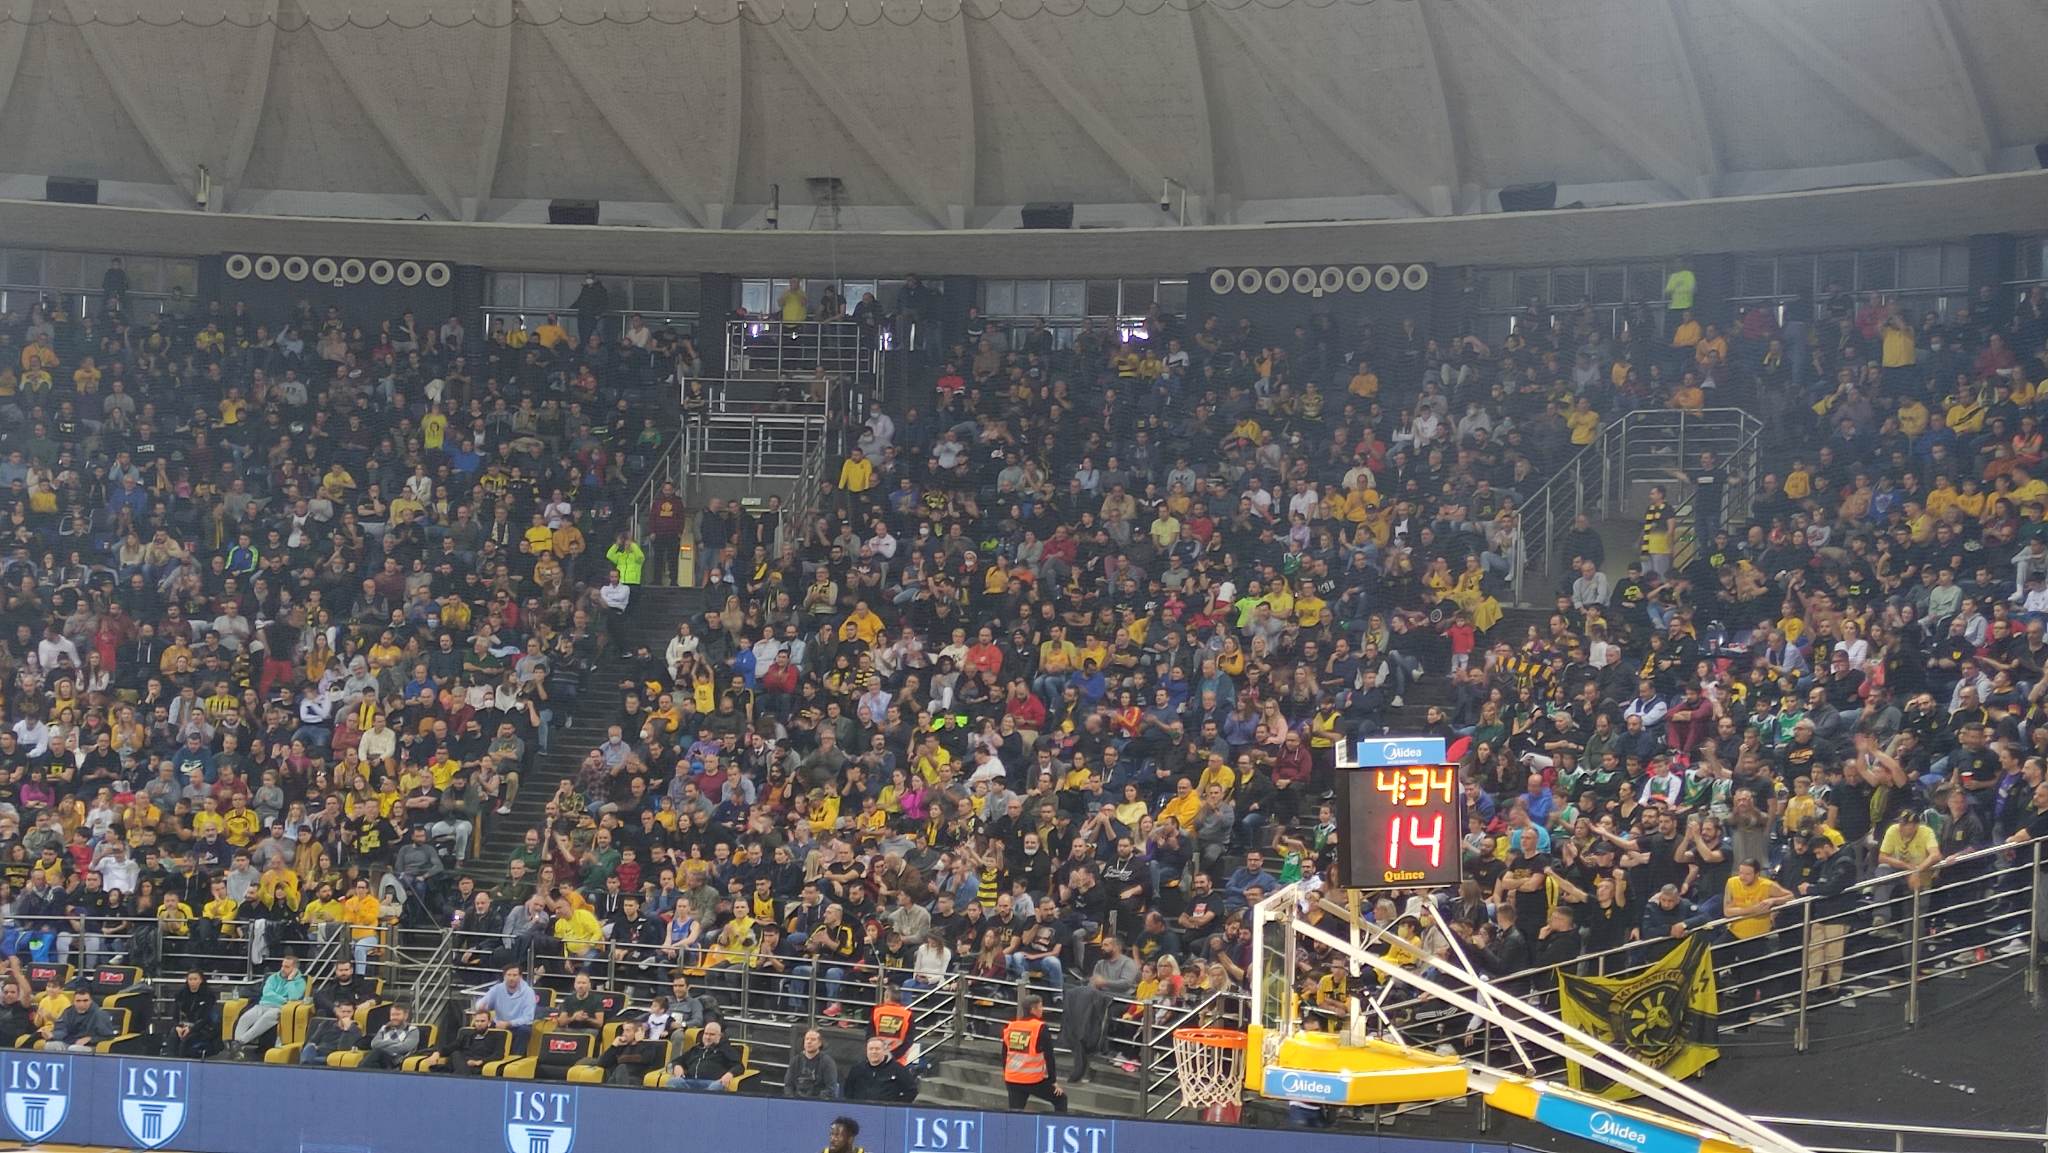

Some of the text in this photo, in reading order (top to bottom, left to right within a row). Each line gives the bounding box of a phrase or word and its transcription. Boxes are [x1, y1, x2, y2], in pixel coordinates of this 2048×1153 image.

[1383, 742, 1422, 760] Midea
[1376, 769, 1453, 806] 4:34
[1389, 815, 1443, 869] 14
[1384, 870, 1425, 882] Quince
[9, 1060, 65, 1092] IST
[126, 1067, 182, 1099] IST
[1281, 1072, 1331, 1094] Midea
[513, 1090, 570, 1123] IST
[914, 1117, 974, 1150] IST
[1045, 1124, 1106, 1153] IST
[1589, 1111, 1646, 1144] Midea
